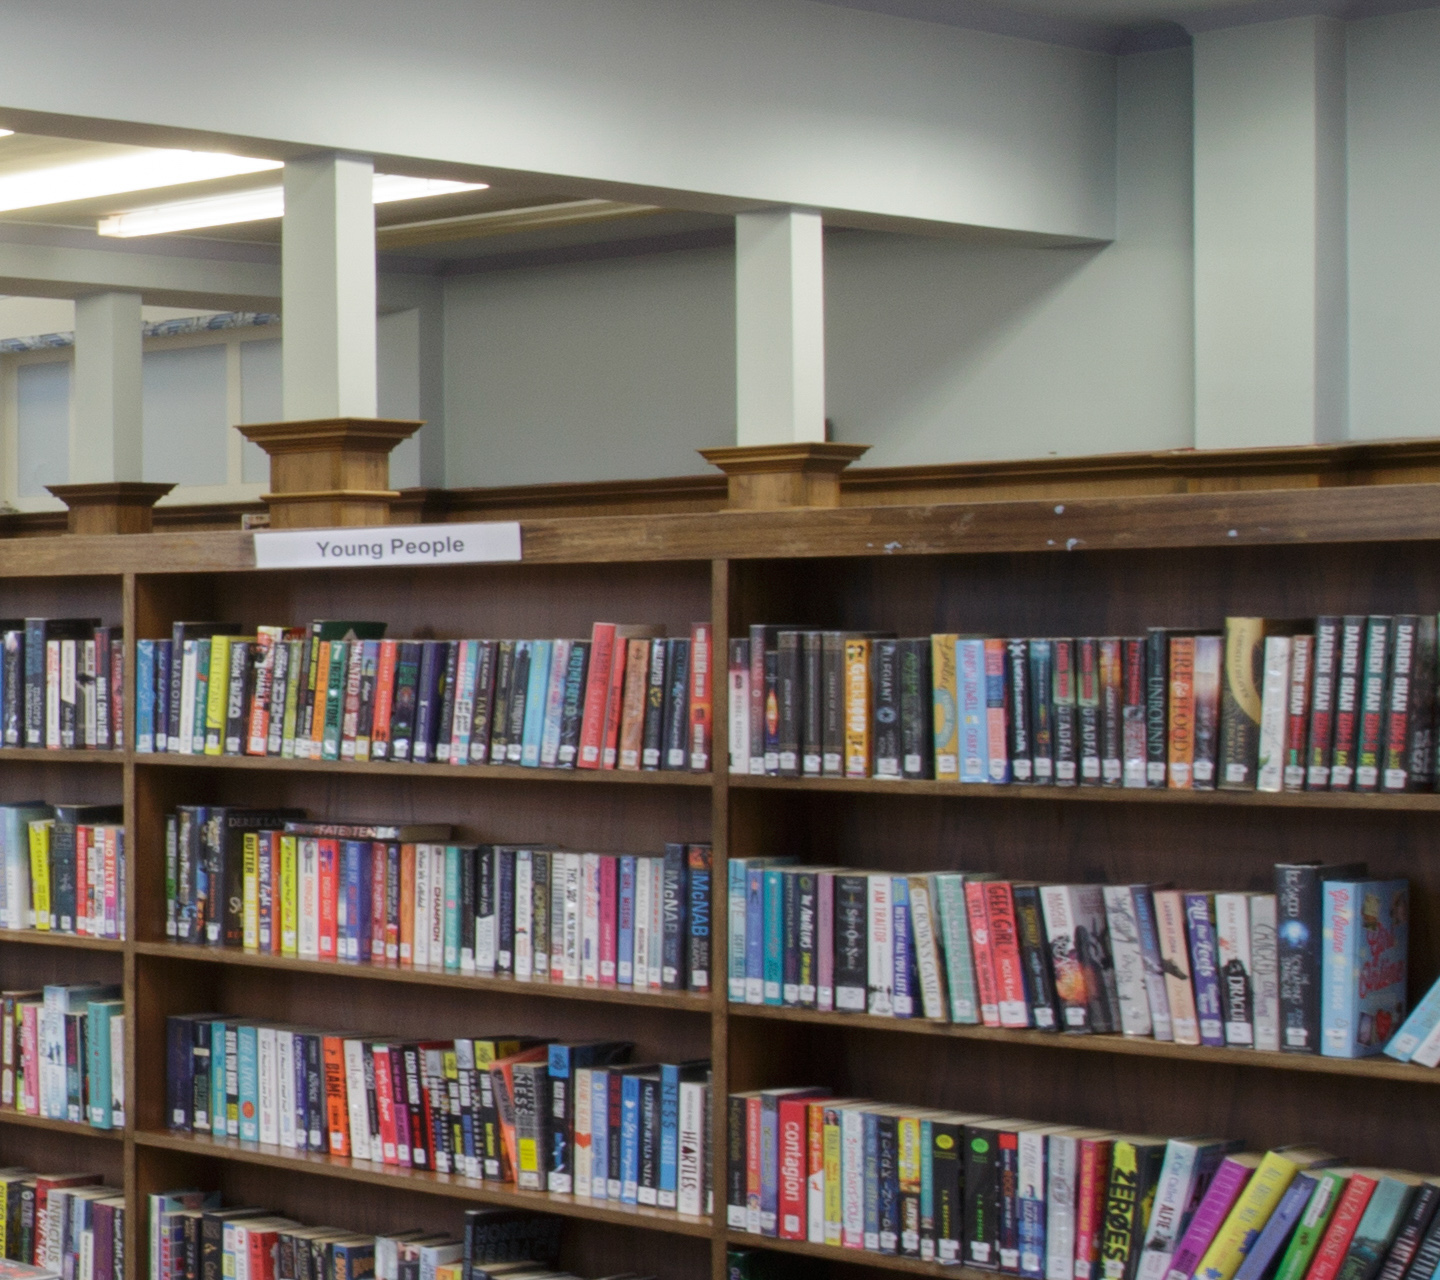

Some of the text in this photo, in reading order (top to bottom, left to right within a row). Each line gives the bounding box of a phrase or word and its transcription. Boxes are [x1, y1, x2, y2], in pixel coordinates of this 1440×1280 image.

[316, 535, 466, 559] Young People
[882, 644, 895, 702] ALLEGIANT
[1171, 640, 1192, 684] FIRE
[1318, 625, 1335, 673] DARREN
[1338, 625, 1360, 711] DARREN SHAN
[1365, 625, 1386, 711] DARREN SHAN
[1391, 624, 1413, 712] DARREN SHAN
[171, 659, 182, 722] MAGONIA
[1148, 677, 1164, 755] UNBOUND
[1290, 685, 1304, 715] SHAN
[1314, 676, 1330, 711] SHAN
[1172, 699, 1188, 752] FLOOD
[104, 839, 116, 898] NO FILTER
[245, 836, 255, 874] BUTTER
[433, 886, 442, 942] CHAMPION
[664, 871, 679, 934] McNAB
[691, 874, 709, 937] McNAB
[873, 890, 887, 944] AM TRAITOR
[988, 885, 1014, 948] GEEK GIRL
[1188, 898, 1208, 929] All
[325, 1062, 342, 1099] BLAME
[348, 1052, 359, 1090] twilight
[514, 1073, 528, 1117] NESS
[663, 1081, 677, 1130] NESS
[782, 1121, 800, 1201] contagion
[49, 1200, 61, 1263] INVICTUS
[1158, 1203, 1174, 1234] ALFIE
[1329, 1179, 1368, 1259] ELIZA ROSE
